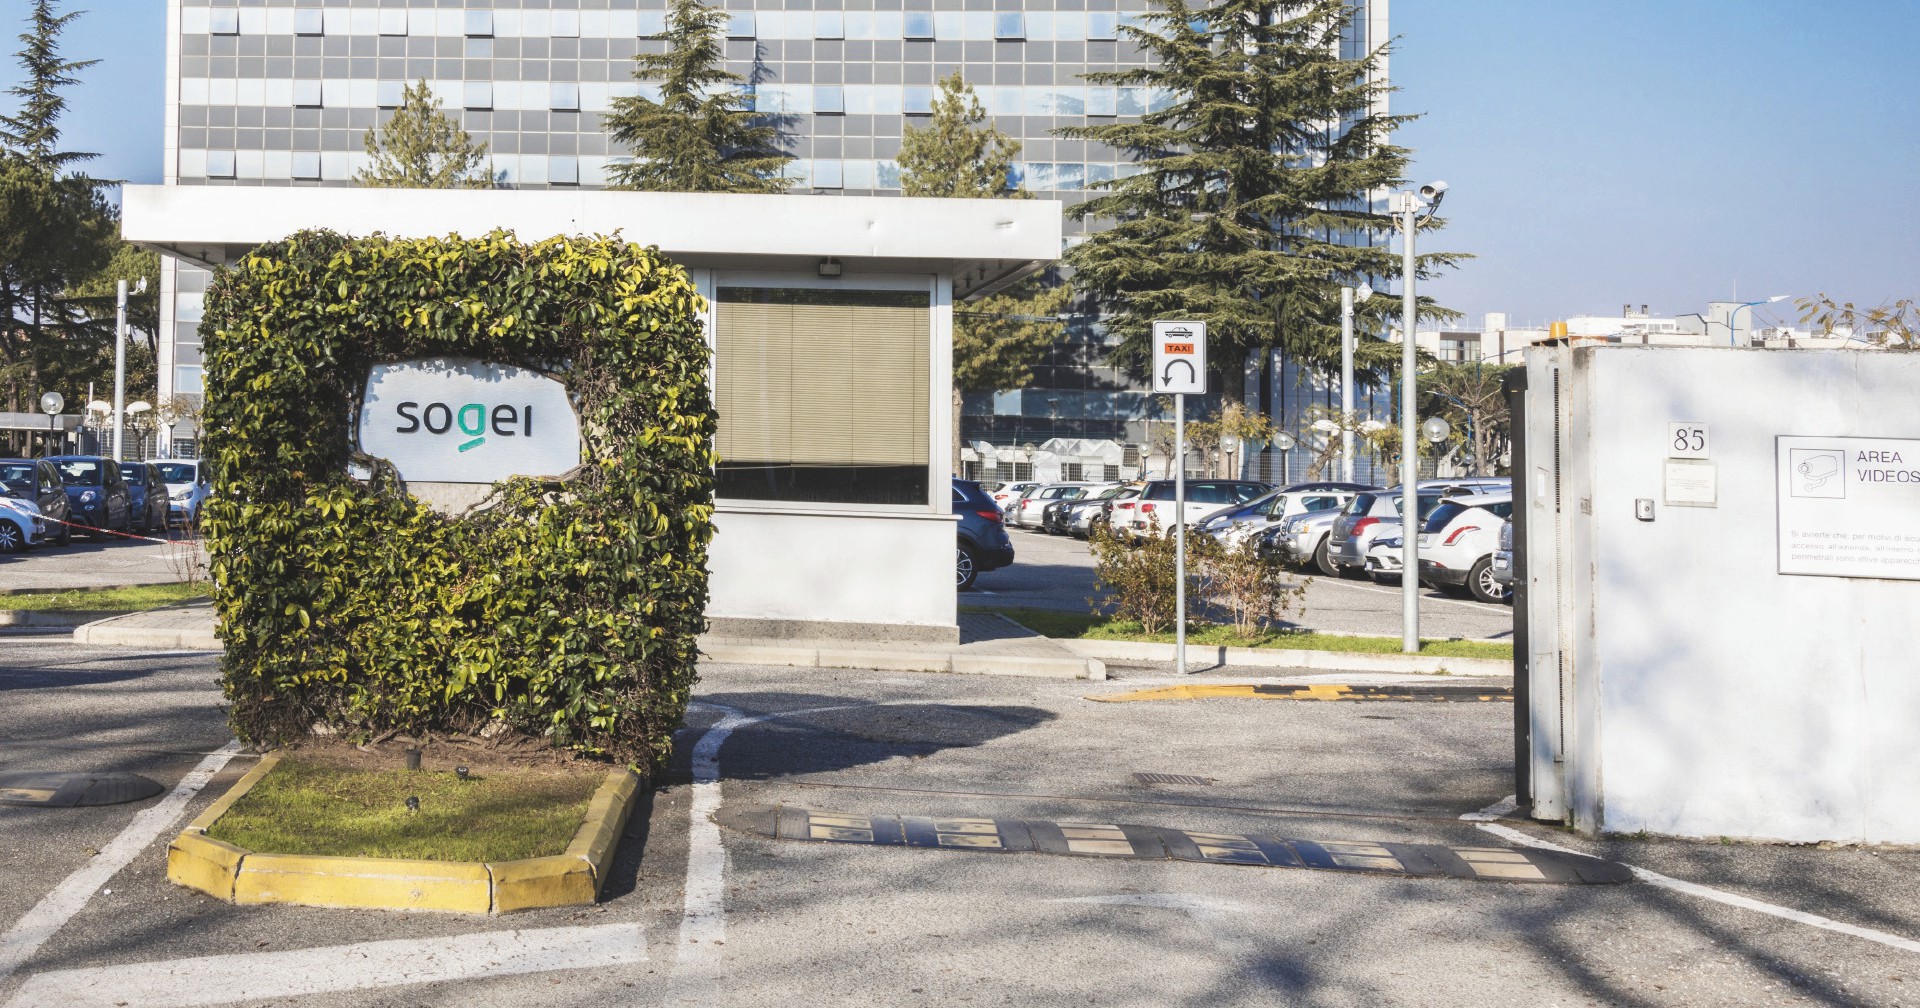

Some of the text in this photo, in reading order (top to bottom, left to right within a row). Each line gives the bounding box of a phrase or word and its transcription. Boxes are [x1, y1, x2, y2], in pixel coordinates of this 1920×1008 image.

[396, 401, 533, 453] sogei
[1674, 428, 1705, 451] 85
[1857, 450, 1903, 463] AREA
[1857, 469, 1920, 482] VIDEOS
